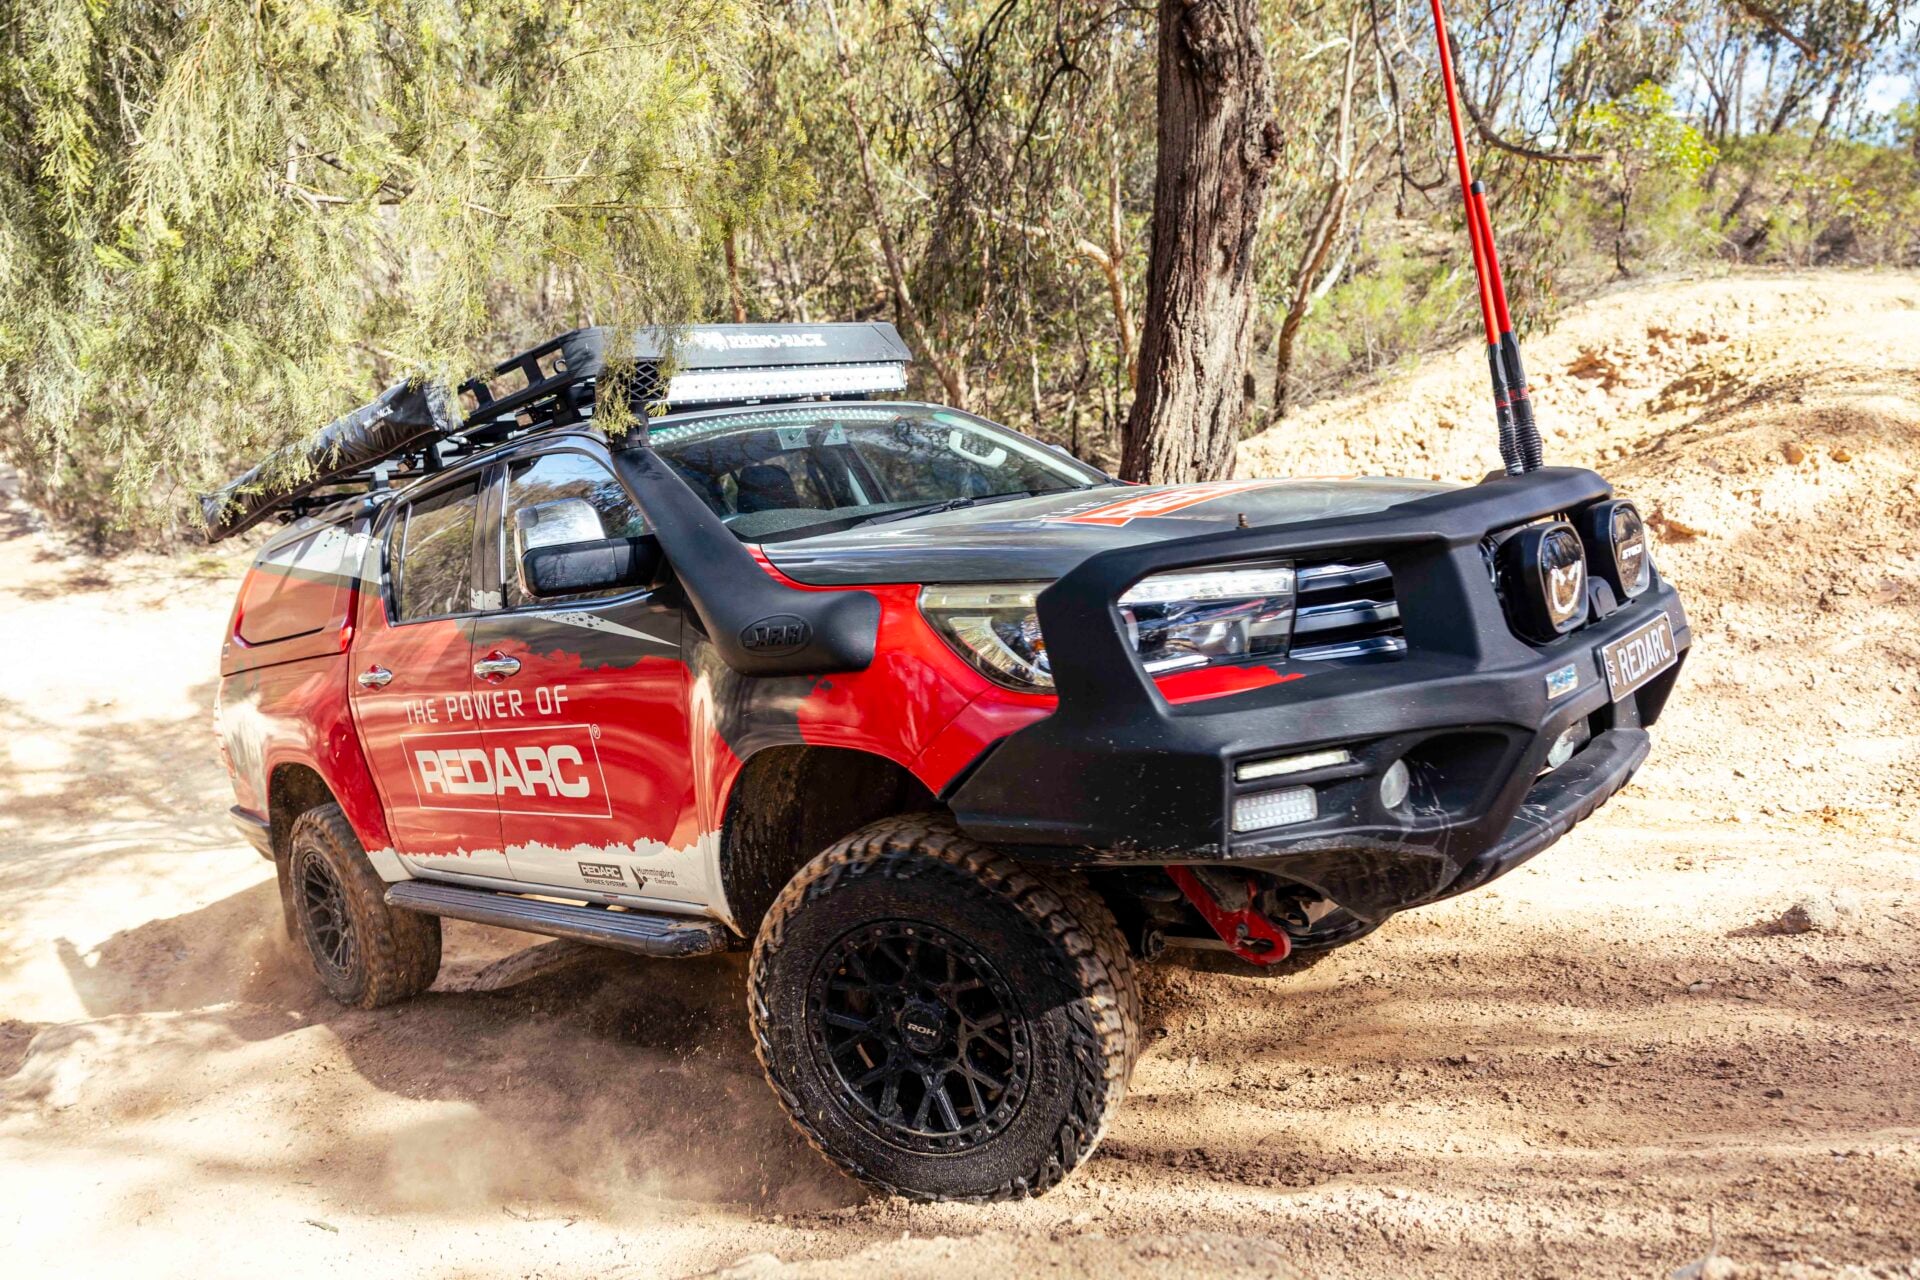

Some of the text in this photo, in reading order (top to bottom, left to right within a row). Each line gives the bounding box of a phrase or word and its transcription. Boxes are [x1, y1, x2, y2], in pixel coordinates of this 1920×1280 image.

[1616, 624, 1671, 687] REDARC
[403, 684, 569, 725] THE POWER OF
[414, 745, 590, 798] REDARC
[580, 864, 622, 879] REDARC
[908, 1022, 937, 1036] ROH
